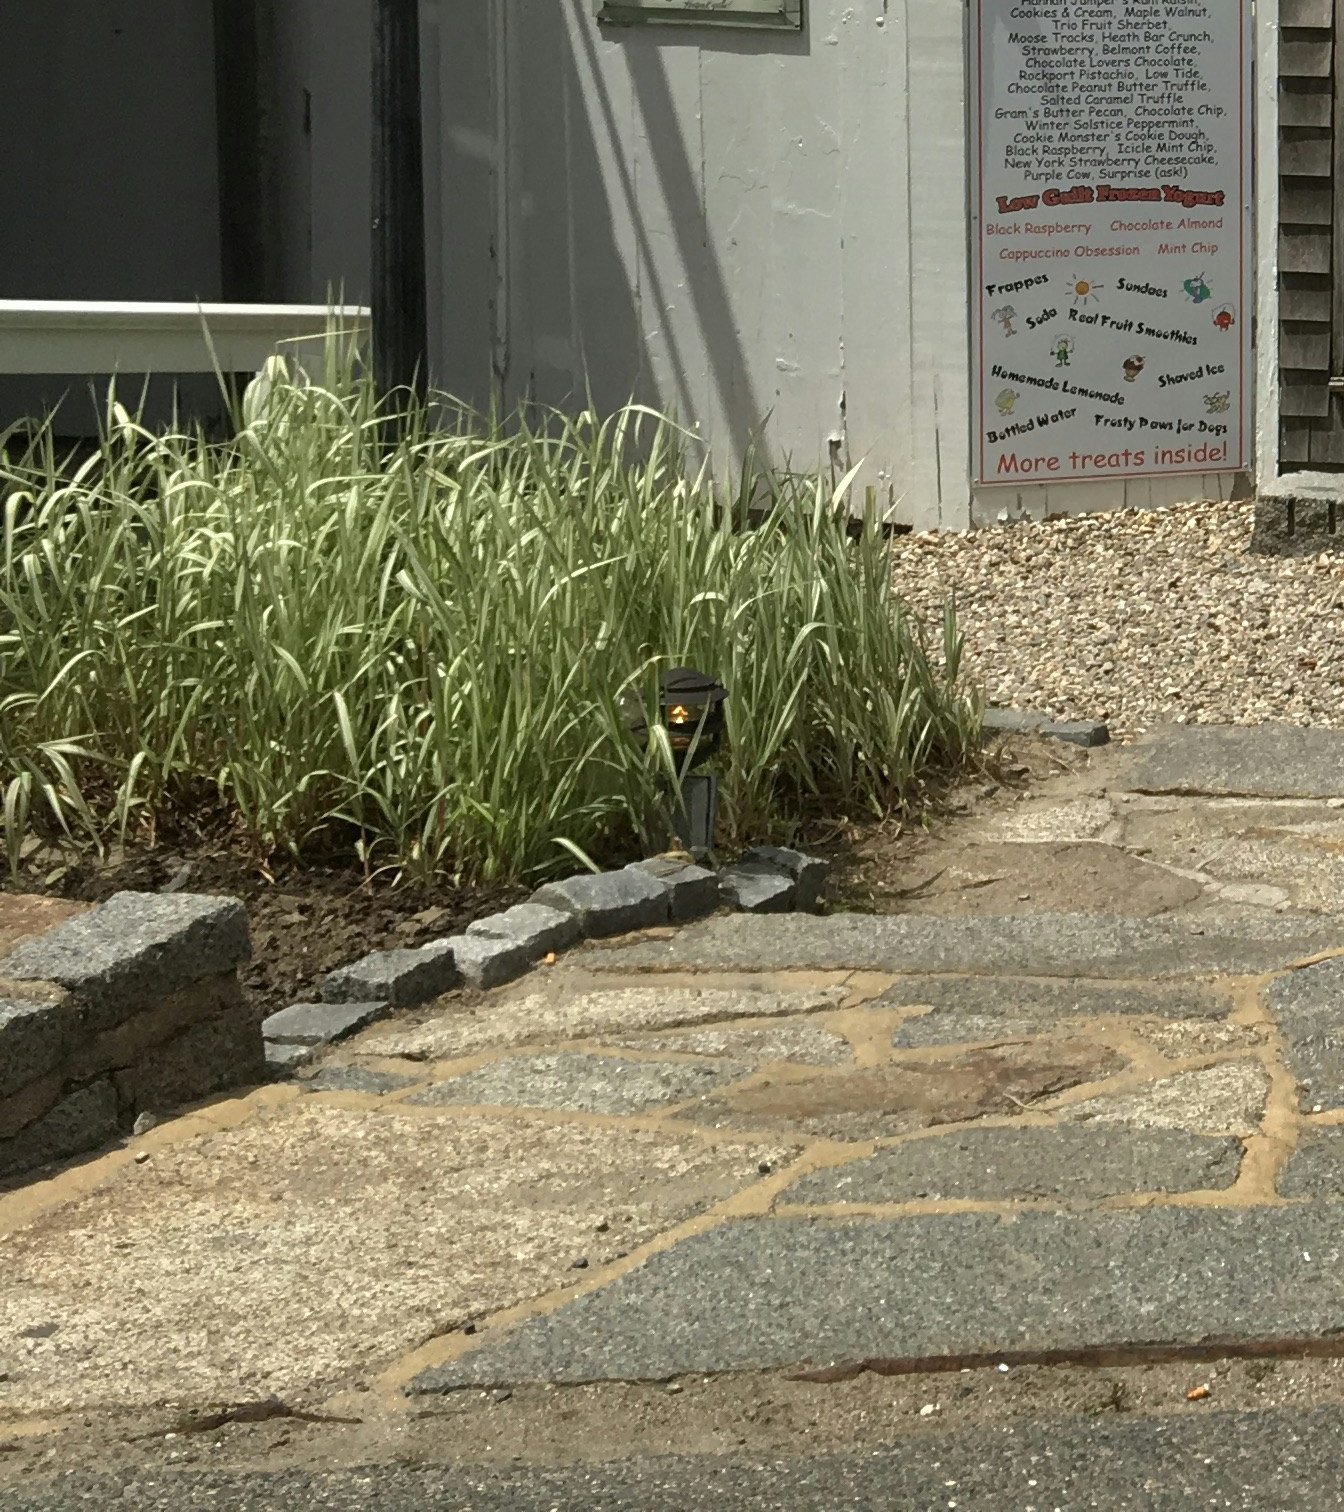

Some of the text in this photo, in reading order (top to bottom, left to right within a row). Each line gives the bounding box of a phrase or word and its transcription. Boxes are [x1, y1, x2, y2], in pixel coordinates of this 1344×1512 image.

[1010, 7, 1211, 20] Cookies & Cream, Maple Walnut,
[1052, 20, 1077, 30] Trio
[1082, 20, 1113, 30] Fruit
[1008, 32, 1214, 44] Moose Tracks, Heath Bar Crunch,
[1022, 44, 1201, 58] Strawberry, Belmont Coffee,
[1026, 58, 1086, 68] Chocolate
[1090, 57, 1130, 68] Lovers
[1019, 70, 1075, 85] Rockport
[1146, 69, 1170, 79] Low
[1008, 81, 1211, 93] Chocolate Peanut Butter Truffle,
[1041, 94, 1183, 106] Salted Caramel Truffle
[994, 105, 1227, 119] Gram's Butter Pecan, Chocolate Chip,
[1026, 120, 1069, 131] Winter
[1074, 120, 1123, 130] Solstice
[1013, 133, 1054, 144] Cookie
[1058, 132, 1120, 143] Monster's
[1125, 131, 1164, 141] Cookie
[1006, 145, 1038, 156] Black
[1117, 144, 1152, 154] Icicle
[1156, 143, 1183, 153] Mint
[1187, 142, 1217, 155] Chip,
[1004, 155, 1218, 169] New York Strawberry Cheesecake,
[1024, 167, 1188, 183] Purple Cow, Surprise (ask!)
[996, 185, 1225, 214] Low Guilt Frozen Yogurt
[987, 223, 1092, 236] Black Raspberry
[1110, 218, 1222, 231] Chocolate Almond
[1000, 246, 1139, 261] Cappuccino Obsession
[1158, 242, 1218, 255] Mint Chip
[986, 274, 1049, 297] Frappes
[1116, 278, 1168, 298] Sundaes
[1026, 307, 1057, 329] Soda
[1069, 308, 1197, 346] Real Fruit Smoothies
[1158, 364, 1225, 388] Shaved Ice
[991, 365, 1125, 405] Homemade Lemonade
[987, 408, 1076, 443] Bottled Water
[1095, 414, 1227, 435] Frosty Paws for Dogs
[997, 441, 1227, 473] More treats inside!
